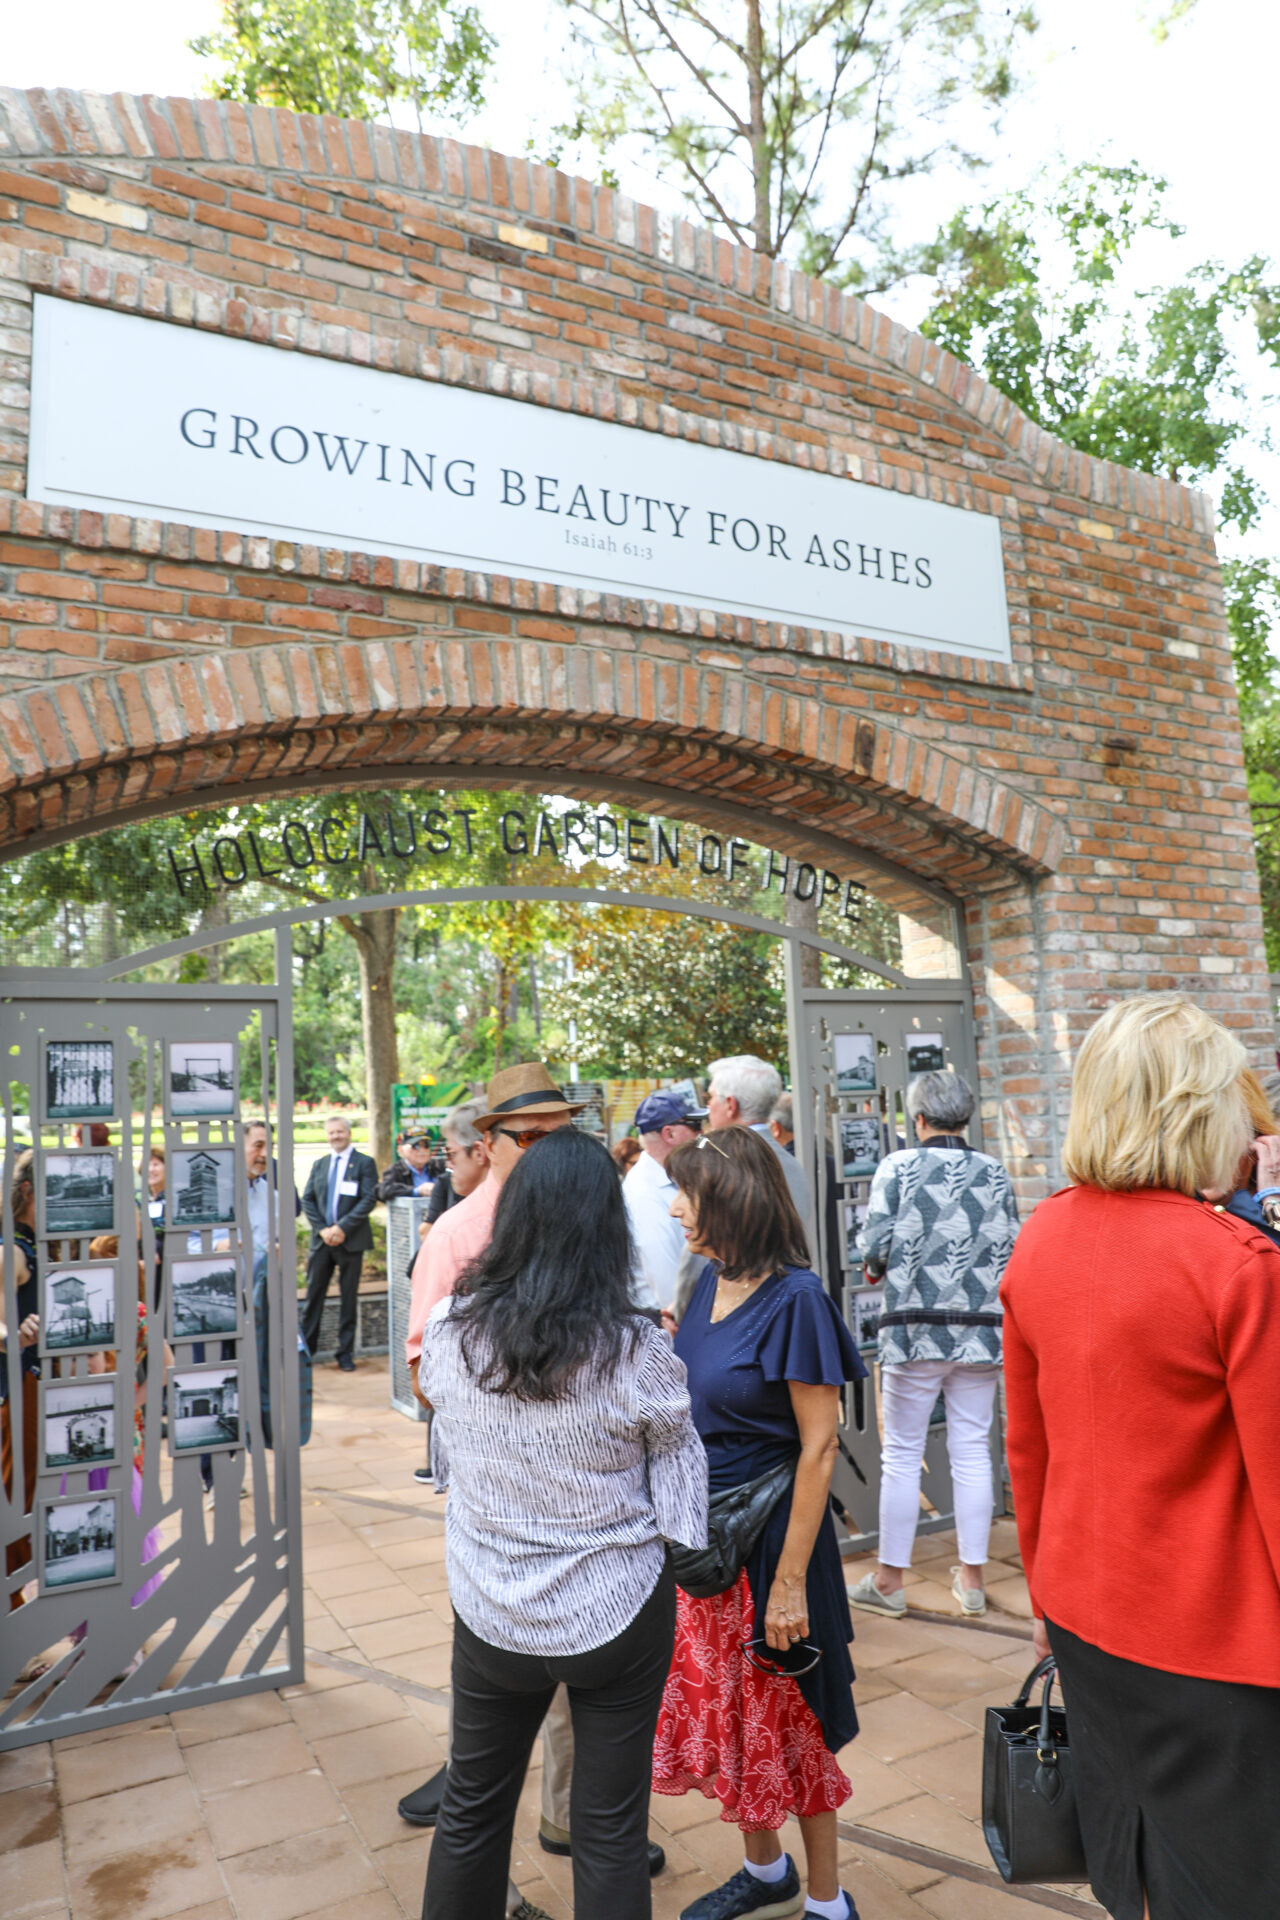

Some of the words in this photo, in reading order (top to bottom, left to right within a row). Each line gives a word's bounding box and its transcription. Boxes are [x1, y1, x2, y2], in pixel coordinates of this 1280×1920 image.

[180, 407, 477, 498] GROWING
[499, 467, 691, 539] BEAUTY
[707, 510, 792, 561] FOR
[803, 533, 933, 590] ASHES
[565, 529, 617, 553] Isaiah
[623, 542, 653, 560] 61:3
[167, 808, 477, 898] HOLOCAUST
[500, 809, 680, 870] GARDEN
[699, 834, 751, 883] OF
[761, 848, 868, 924] HOPE
